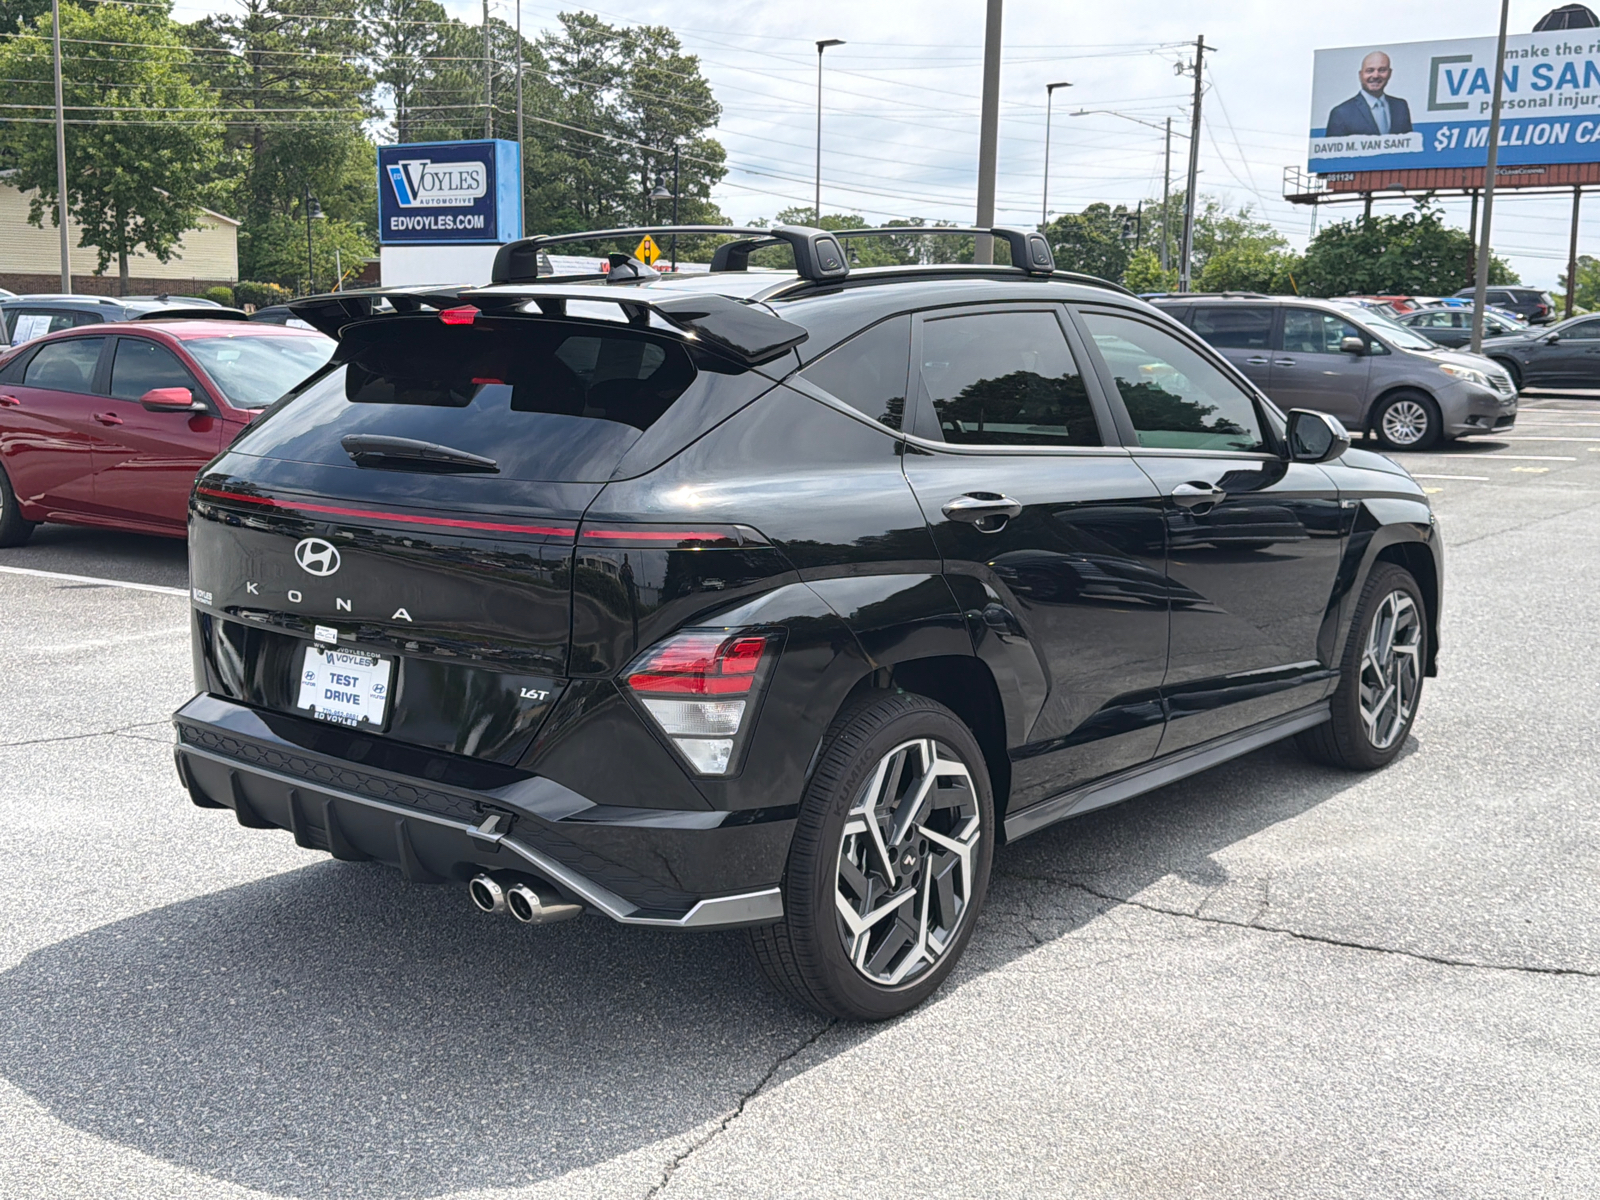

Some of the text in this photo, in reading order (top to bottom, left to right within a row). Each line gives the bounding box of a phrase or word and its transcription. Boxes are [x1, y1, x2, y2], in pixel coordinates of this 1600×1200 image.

[1504, 44, 1550, 59] make
[1555, 42, 1583, 56] the
[1445, 65, 1519, 96] VAN
[1479, 91, 1600, 114] prsonal injur
[1433, 125, 1460, 152] $1
[1463, 122, 1571, 149] MLLION
[1314, 138, 1412, 154] DAVID M. VAN SANT
[394, 172, 401, 180] ED
[401, 163, 480, 201] VOYLES
[420, 197, 472, 205] AUTOMOTIVE
[390, 215, 485, 230] EDVOYLES.COM
[246, 581, 413, 622] KONA
[336, 653, 372, 667] VOYLES
[329, 672, 360, 688] TEST
[324, 688, 361, 706] DRIVE
[314, 711, 358, 727] ED VOYLES
